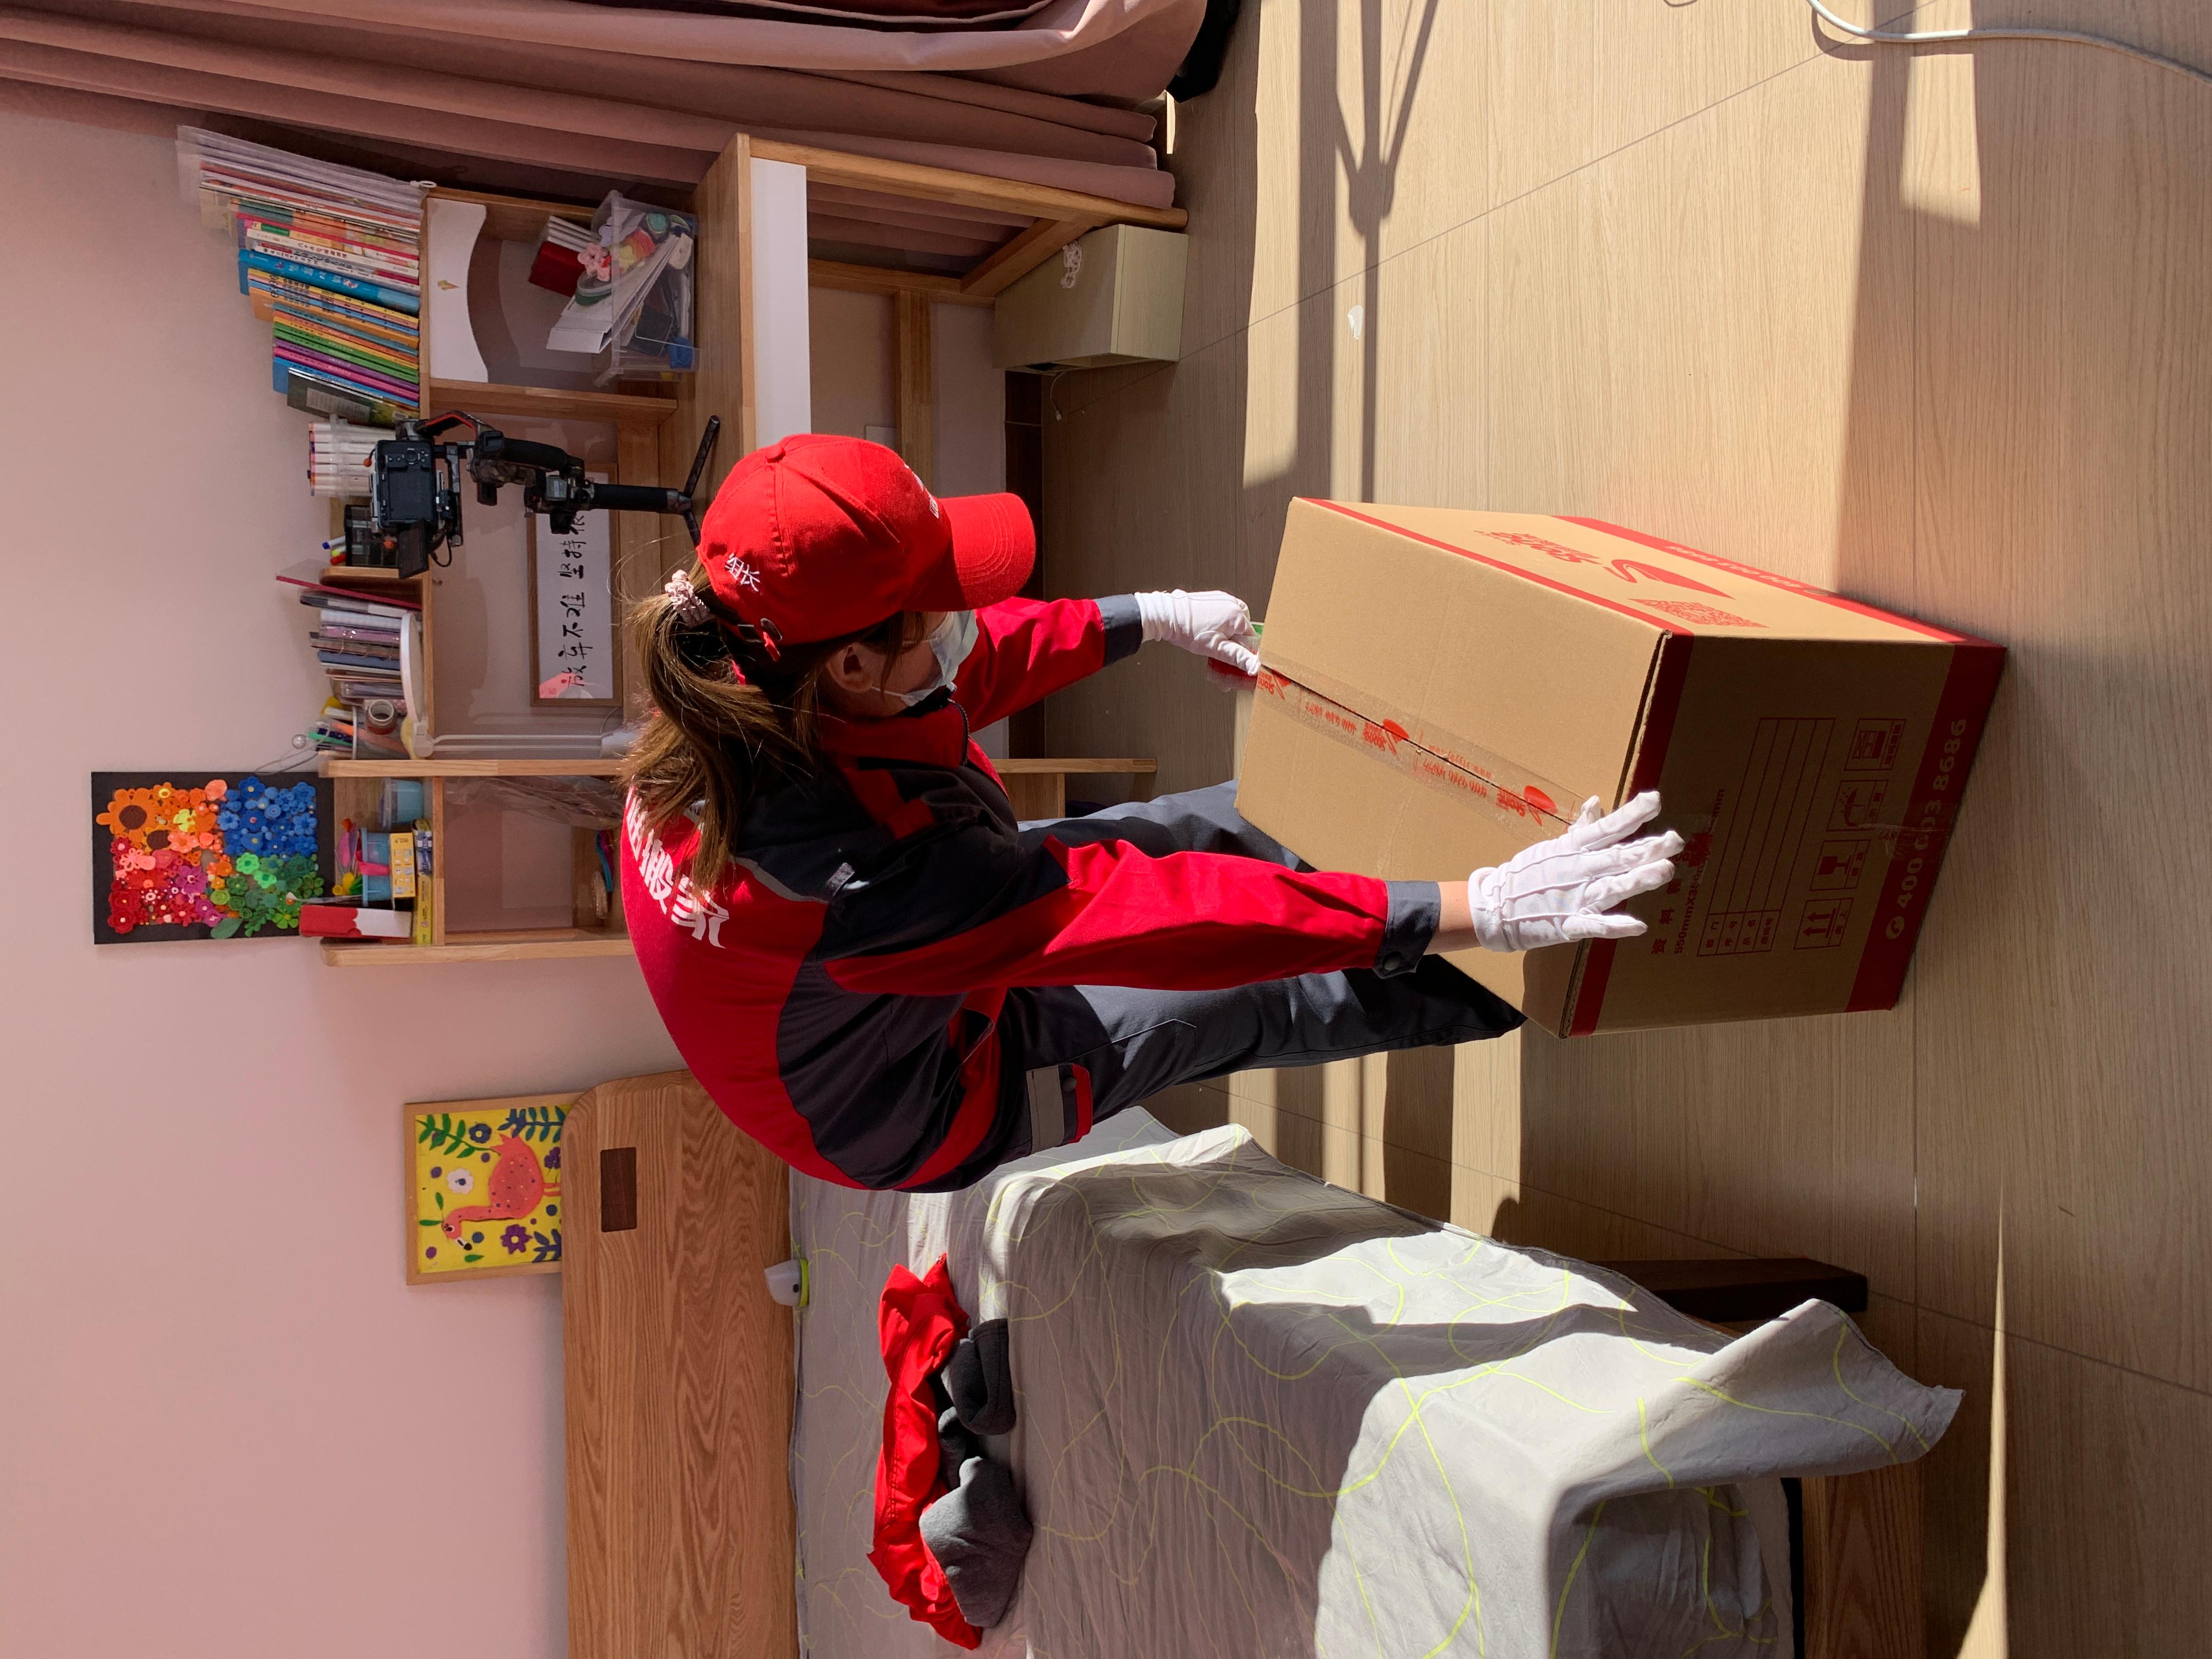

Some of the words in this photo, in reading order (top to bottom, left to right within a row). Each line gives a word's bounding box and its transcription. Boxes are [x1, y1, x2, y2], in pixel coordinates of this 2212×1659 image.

[724, 552, 760, 592] 组长
[1489, 532, 1601, 564] Stone
[558, 591, 592, 687] 放弃不难
[1897, 857, 1924, 908] 400
[1932, 719, 1967, 791] 8686
